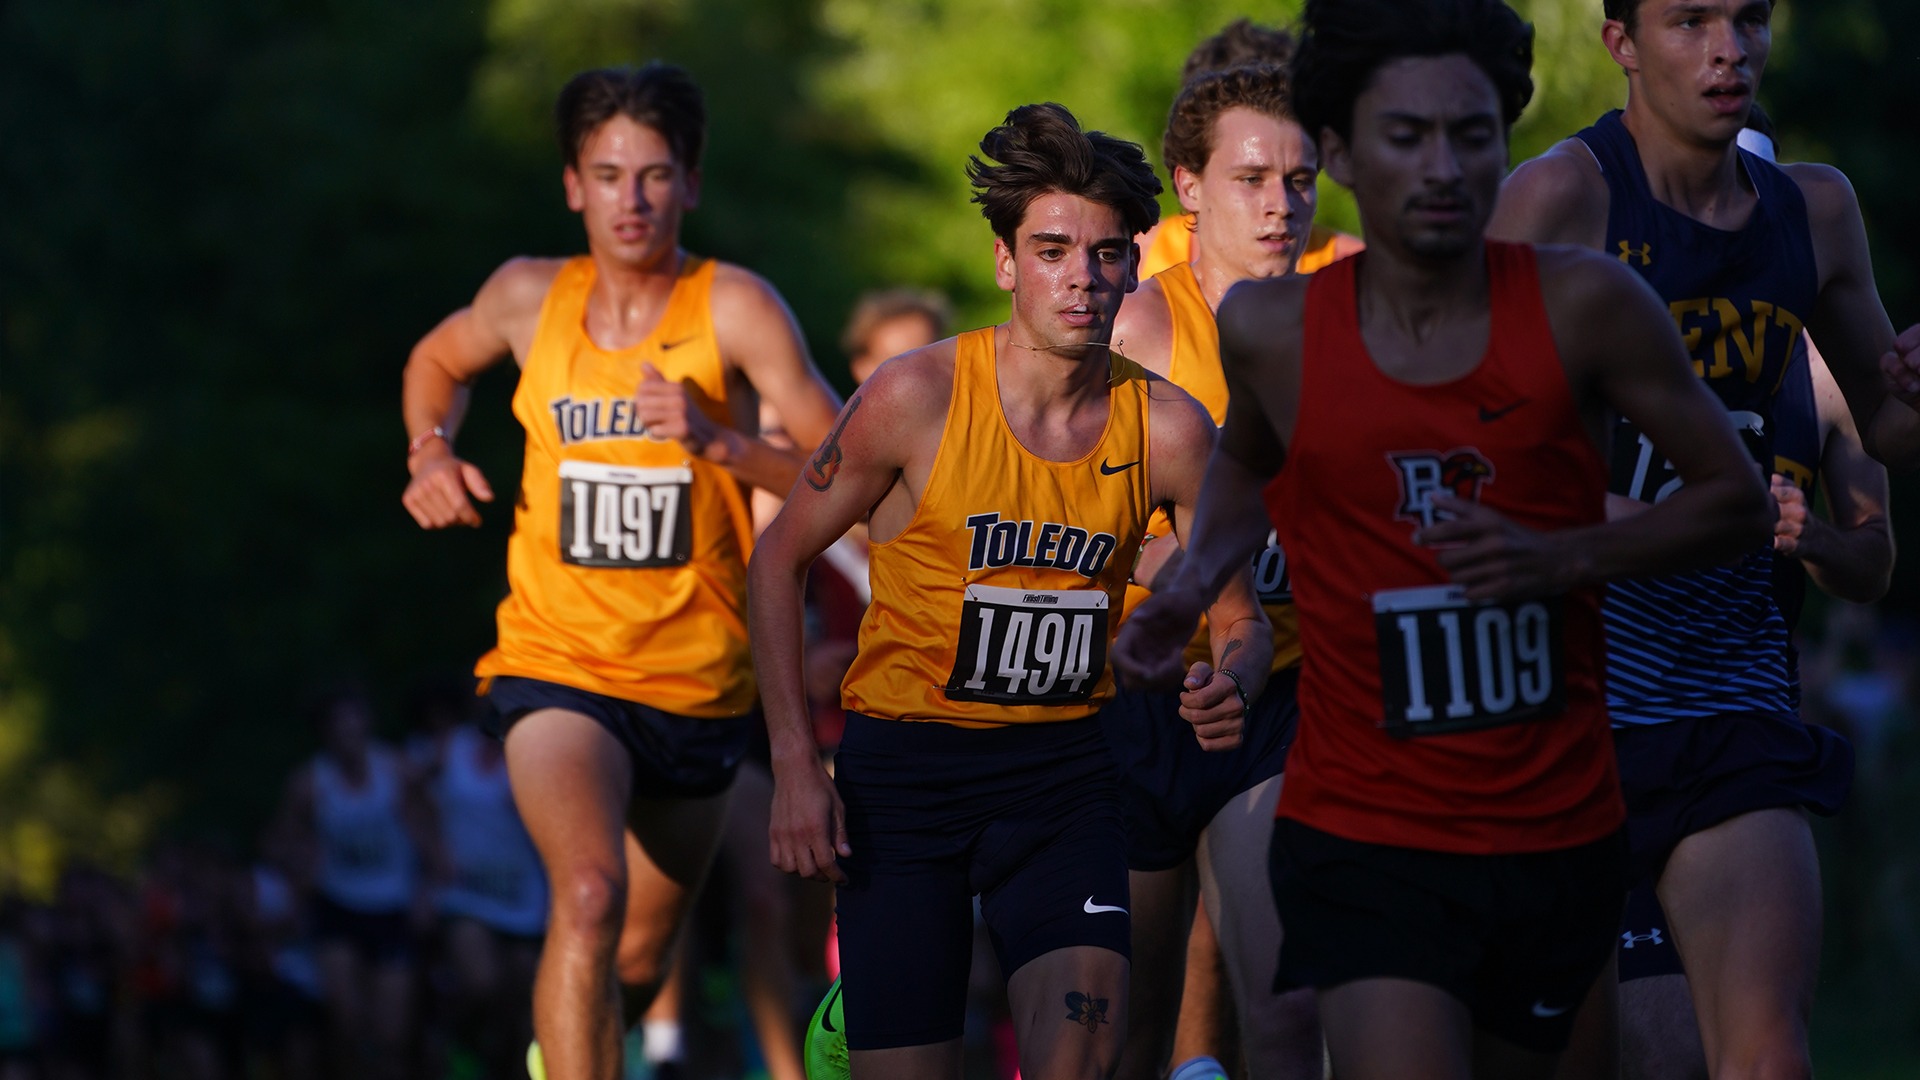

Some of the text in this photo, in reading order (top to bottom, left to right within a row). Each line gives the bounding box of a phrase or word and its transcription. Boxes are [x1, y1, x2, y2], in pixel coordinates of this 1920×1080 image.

[1668, 296, 1803, 396] ENT
[552, 395, 670, 444] TOLED
[570, 481, 680, 562] 1497
[966, 512, 1117, 579] TOLEDO
[964, 607, 1094, 696] 1494
[1397, 603, 1552, 722] 1109
